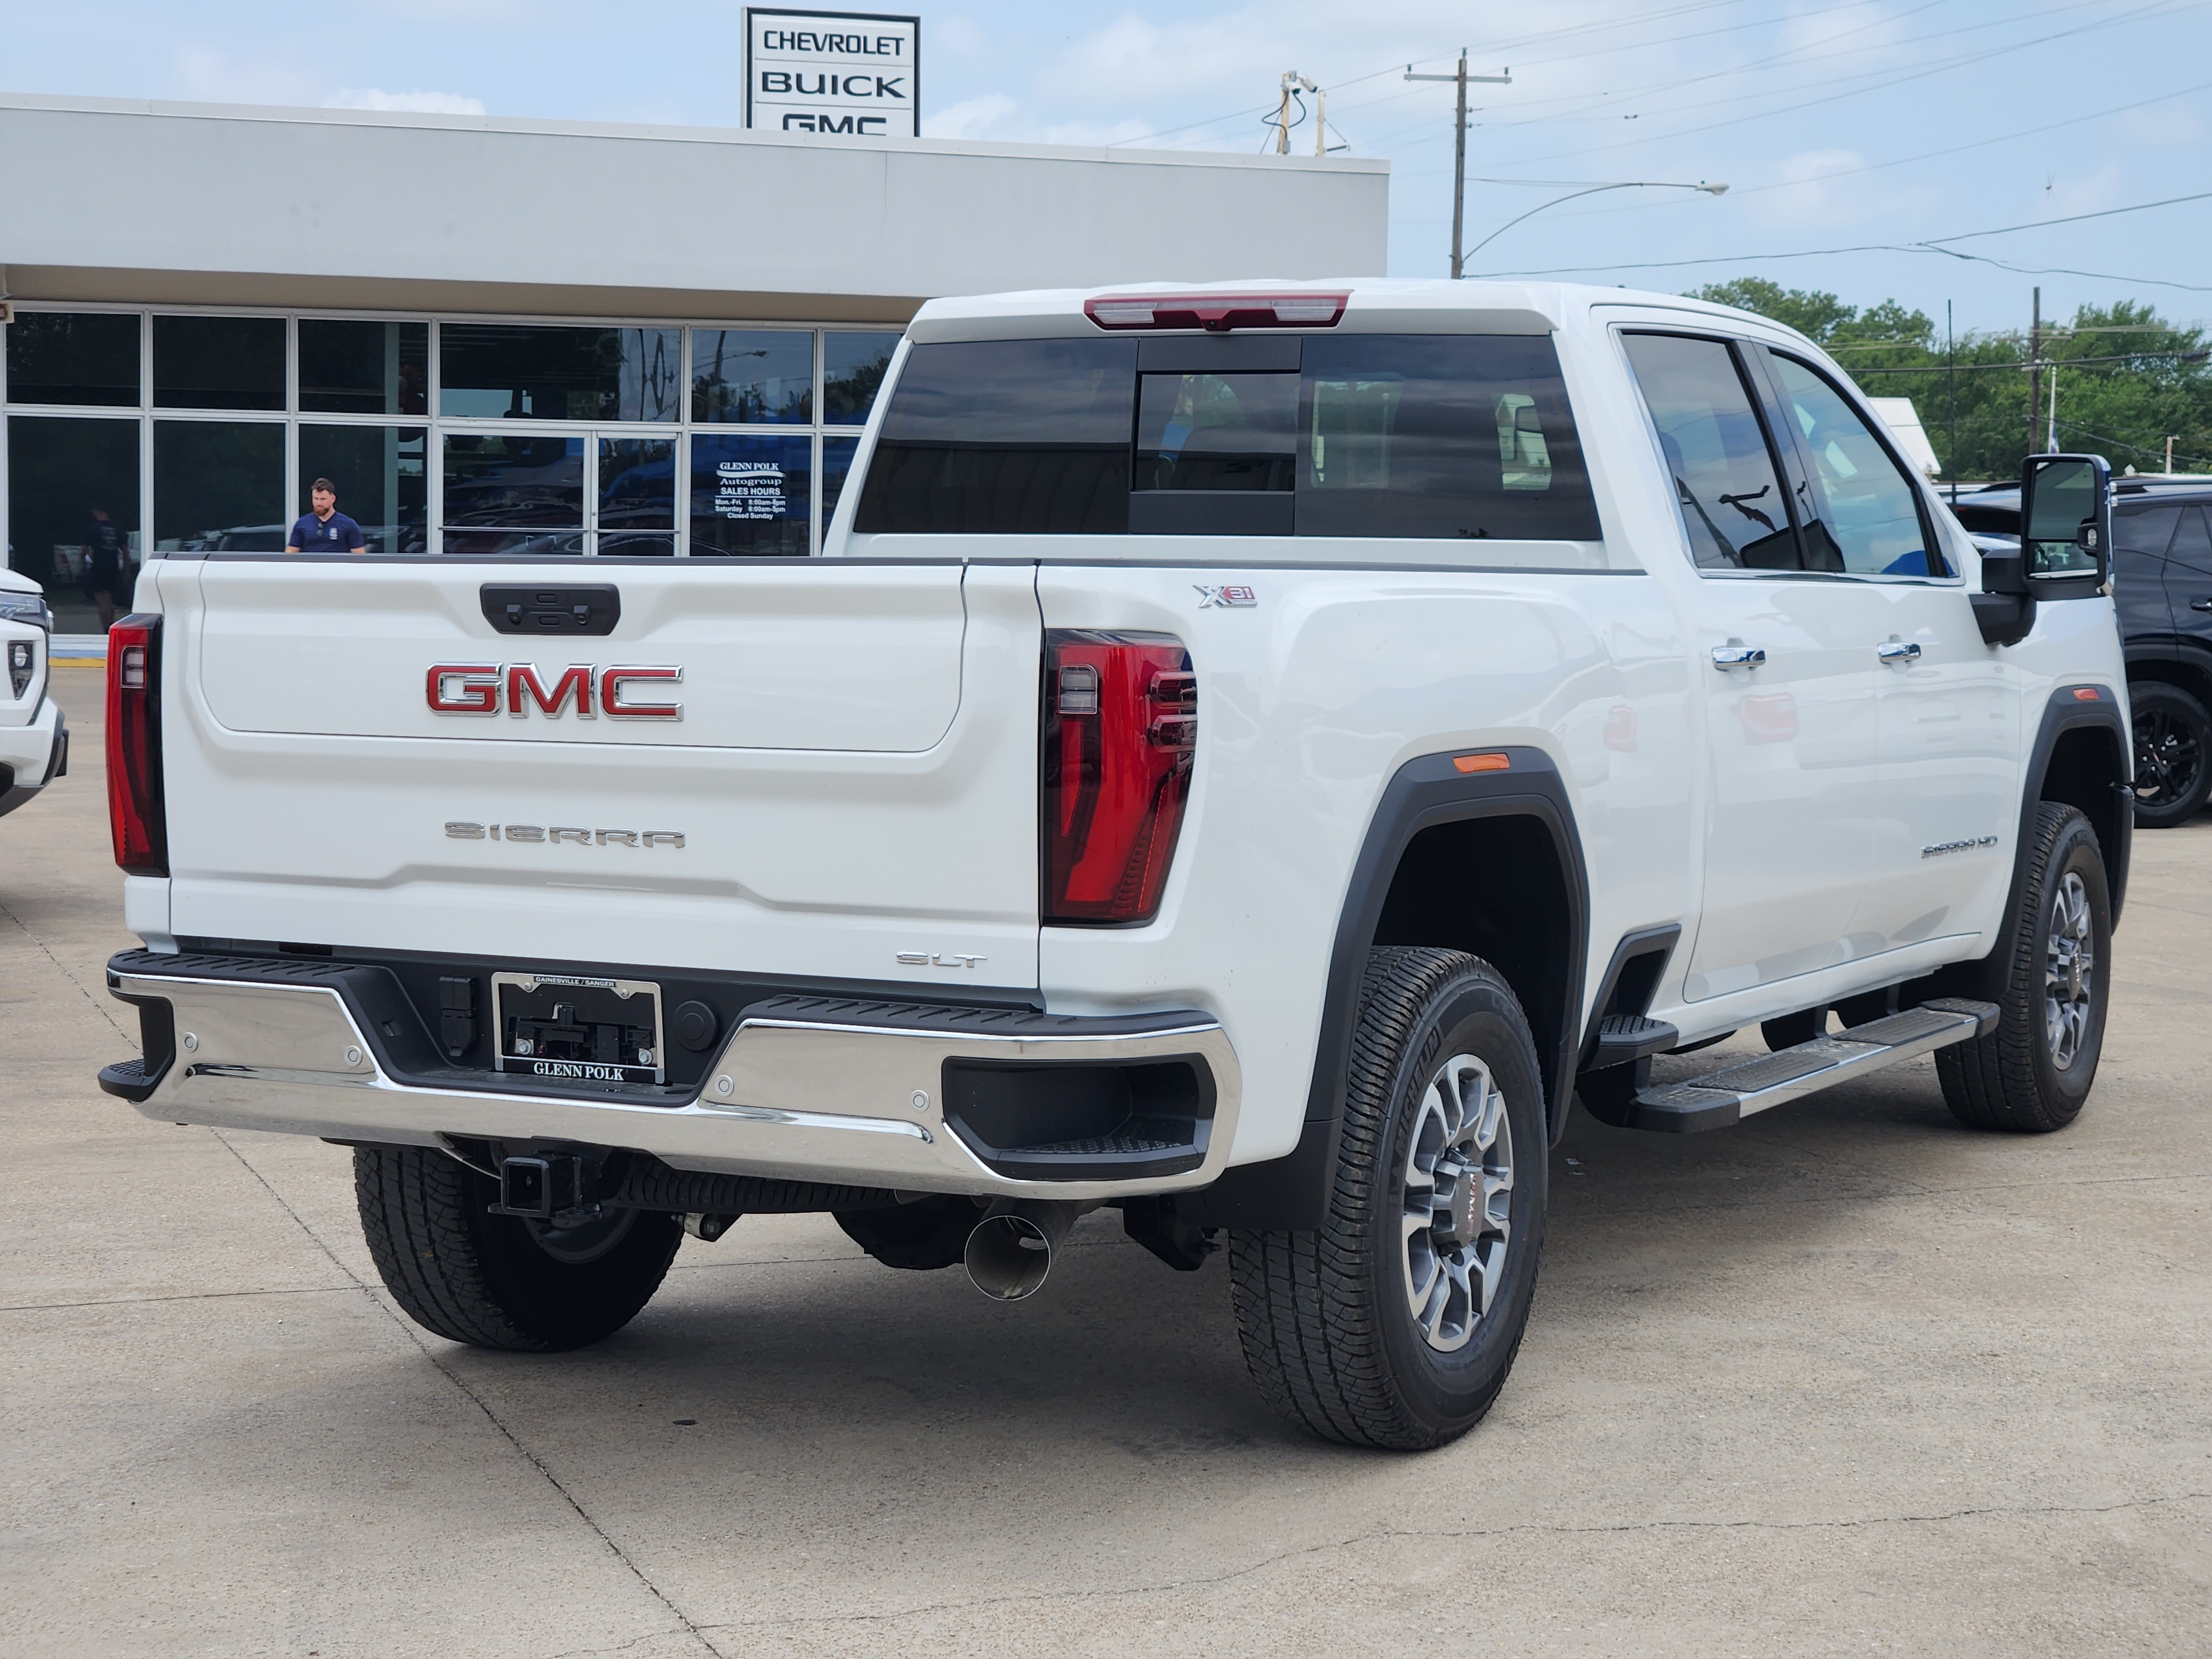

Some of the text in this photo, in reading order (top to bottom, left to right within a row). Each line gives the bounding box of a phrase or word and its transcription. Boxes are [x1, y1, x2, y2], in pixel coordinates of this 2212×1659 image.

[764, 30, 905, 56] CHEVROLET
[761, 71, 907, 98] BUICK
[782, 113, 887, 137] GMC
[719, 462, 779, 471] GLENN POLK
[1192, 585, 1258, 609] X31
[425, 661, 684, 722] GMC
[444, 820, 686, 849] SIERRA
[896, 951, 988, 968] SLT
[534, 1062, 624, 1081] GLENN POLK
[1395, 1026, 1442, 1160] MICHELIN
